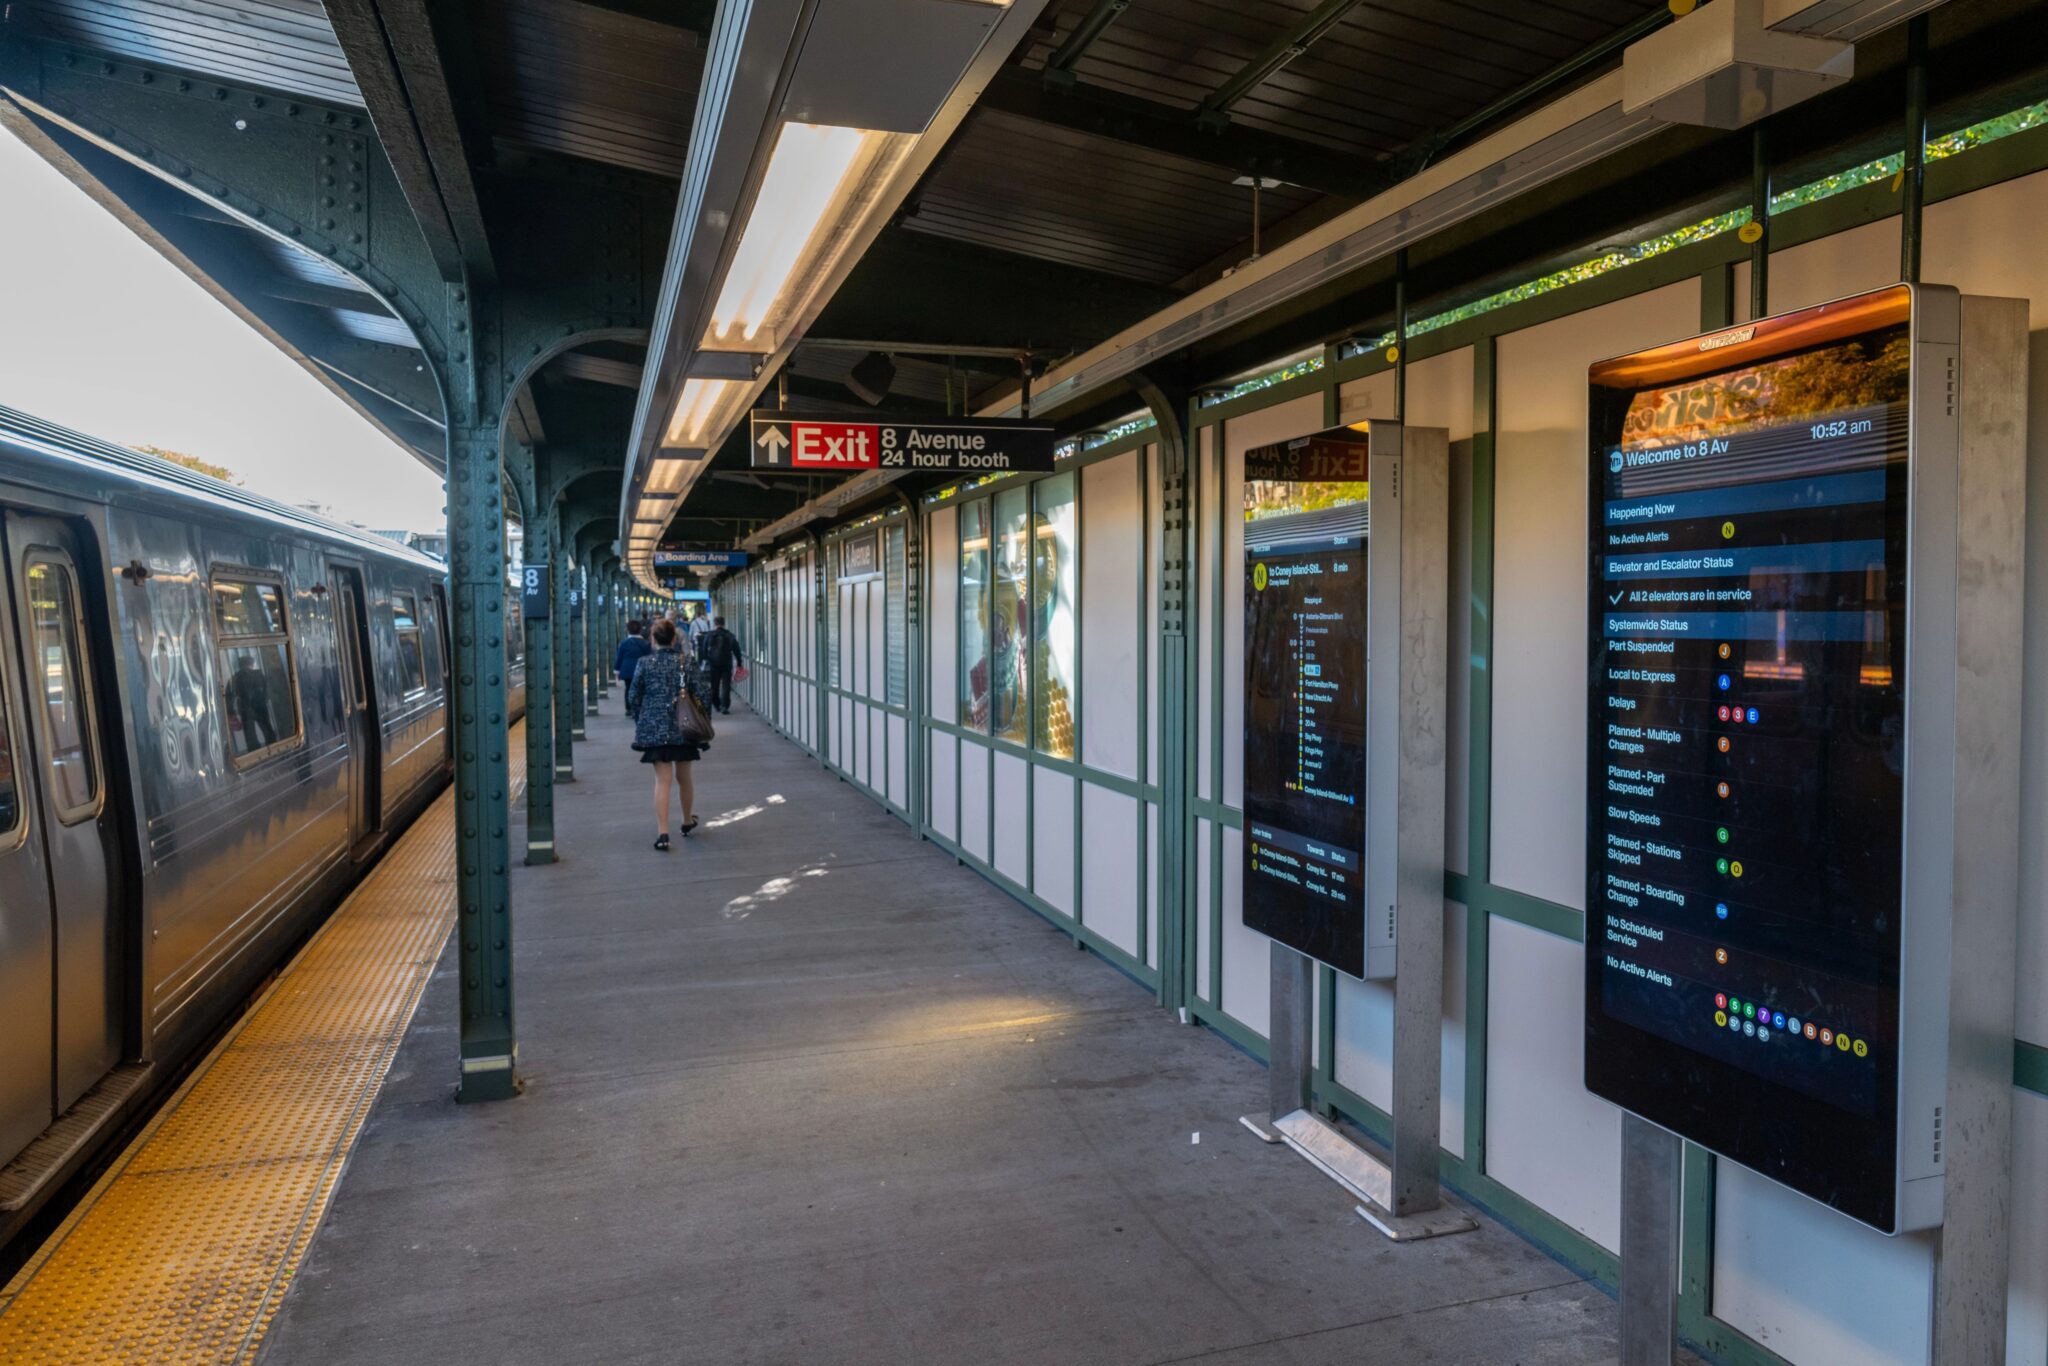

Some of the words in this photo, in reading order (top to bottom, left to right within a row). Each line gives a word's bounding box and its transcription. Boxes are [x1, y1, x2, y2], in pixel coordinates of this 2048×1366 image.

[1810, 420, 1847, 439] 10:52
[1850, 420, 1872, 434] am
[797, 427, 870, 462] Exit
[881, 428, 897, 448] 8
[906, 429, 985, 450] Avenue
[881, 450, 905, 466] 24
[912, 451, 955, 467] hour
[958, 451, 1010, 468] booth
[1626, 449, 1681, 467] Welcome
[1683, 445, 1696, 458] to
[1699, 440, 1708, 456] 8
[1710, 439, 1729, 455] Av
[1609, 505, 1653, 520] Happening
[1654, 504, 1675, 515] Now
[1609, 535, 1620, 545] No
[1621, 533, 1644, 544] Active
[1645, 532, 1669, 542] Alerts
[665, 552, 706, 563] Boarding
[708, 553, 729, 561] Area
[1609, 561, 1642, 573] Elevator
[1643, 559, 1660, 571] and
[1661, 559, 1702, 570] Escalator
[1703, 557, 1734, 568] Status
[525, 569, 539, 587] 8
[1276, 566, 1292, 577] Coney
[526, 587, 538, 595] Av
[1629, 591, 1641, 602] All
[1641, 591, 1648, 601] 2
[1649, 590, 1689, 602] elevators
[1690, 592, 1705, 601] are
[1706, 589, 1715, 600] in
[1716, 589, 1752, 600] service
[1609, 619, 1658, 632] Systemwide
[1660, 620, 1688, 631] Status
[1609, 640, 1626, 651] Part
[1627, 641, 1674, 653] Suspended
[1609, 669, 1631, 680] Local
[1631, 670, 1640, 680] to
[1641, 671, 1676, 683] Express
[1608, 697, 1636, 710] Delays
[1608, 725, 1641, 738] Planned
[1647, 729, 1681, 744] Multiple
[1608, 739, 1644, 754] Changes
[1608, 766, 1641, 780] Planned
[1647, 772, 1665, 784] Part
[1608, 781, 1654, 797] Suspended
[1608, 807, 1628, 819] Slow
[1629, 811, 1661, 826] Speeds
[1607, 834, 1640, 850] Planned
[1646, 842, 1681, 859] Stations
[1607, 848, 1641, 865] Skipped
[1607, 875, 1640, 892] Planned
[1646, 885, 1685, 906] Boarding
[1607, 889, 1639, 907] Change
[1607, 915, 1619, 927] No
[1620, 918, 1663, 941] Scheduled
[1607, 929, 1638, 948] Service
[1607, 956, 1619, 968] No
[1620, 961, 1646, 978] Active
[1646, 970, 1672, 987] Alerts
